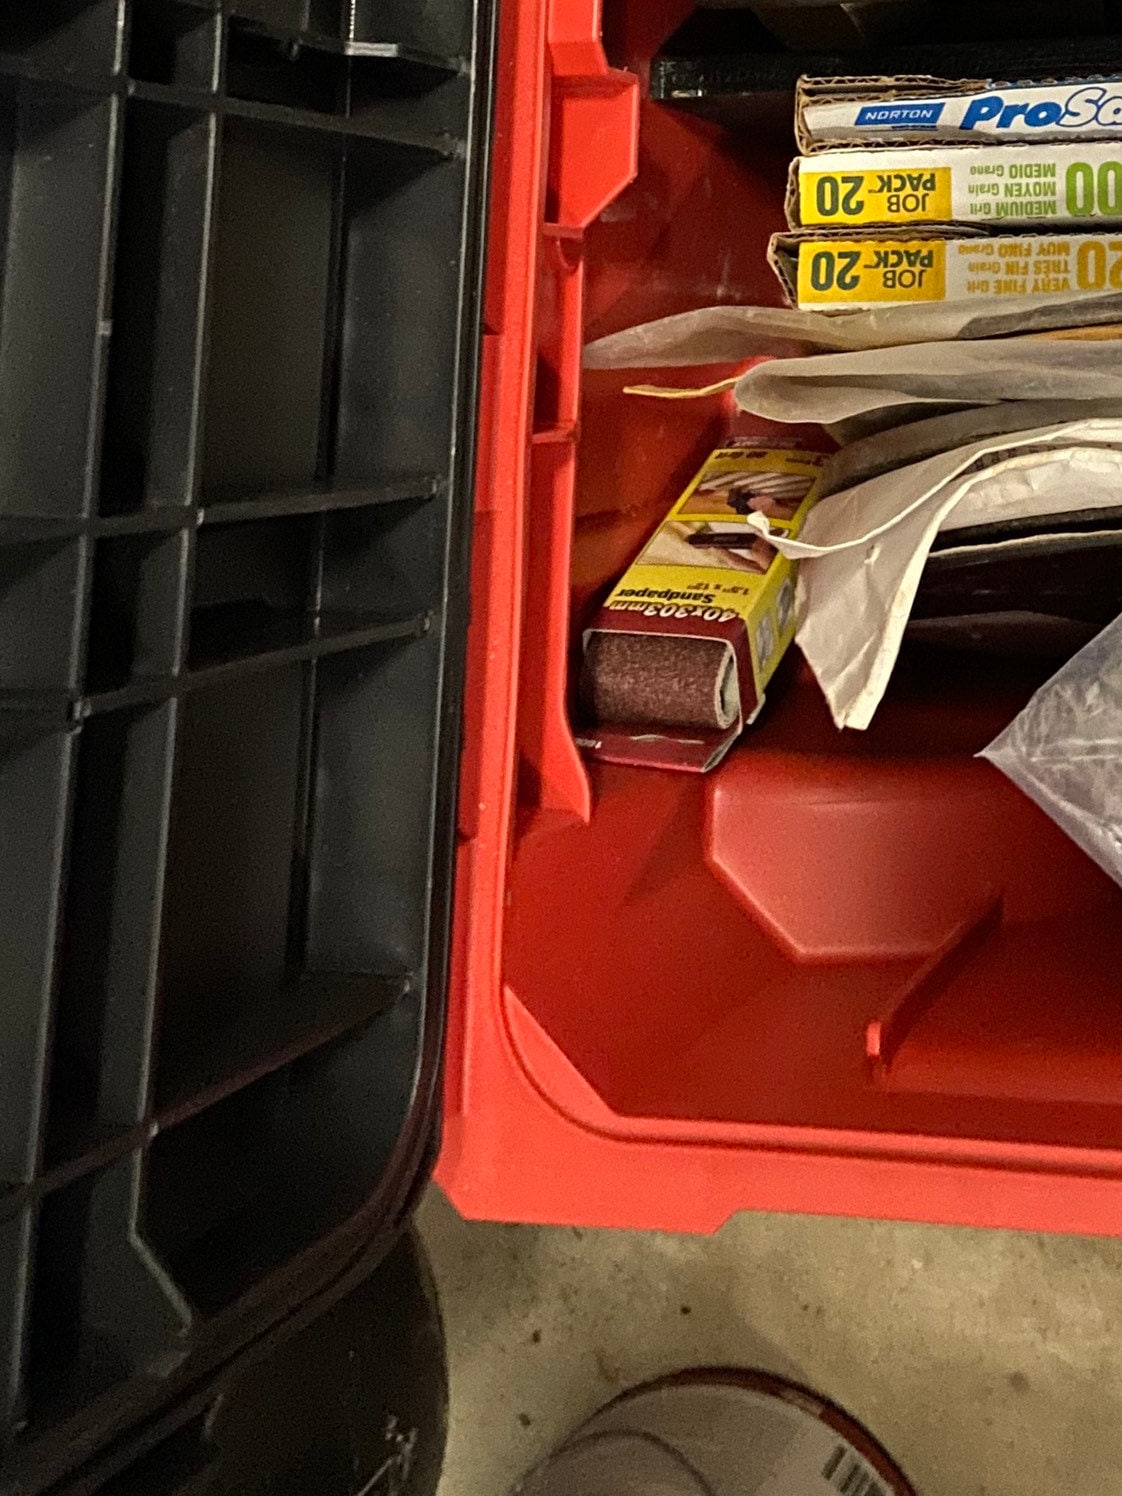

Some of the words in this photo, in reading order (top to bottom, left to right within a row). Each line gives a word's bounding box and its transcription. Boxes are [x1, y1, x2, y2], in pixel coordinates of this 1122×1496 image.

[865, 108, 934, 124] NORTON
[969, 164, 1004, 177] Grano
[1008, 163, 1057, 179] MEDIO
[816, 175, 865, 217] 20
[967, 182, 1000, 197] Grain
[1004, 181, 1057, 197] MOYEN
[886, 192, 930, 213] JOB
[968, 201, 991, 215] Grit
[994, 200, 1057, 217] MEDIUM
[1036, 242, 1070, 258] MUY
[810, 250, 861, 291] 20
[1004, 260, 1029, 276] FIN
[882, 268, 925, 289] JOB
[993, 278, 1028, 294] FINE
[1035, 278, 1070, 294] VERY
[615, 587, 716, 605] Sandpaper
[608, 601, 739, 623] 40x303mm
